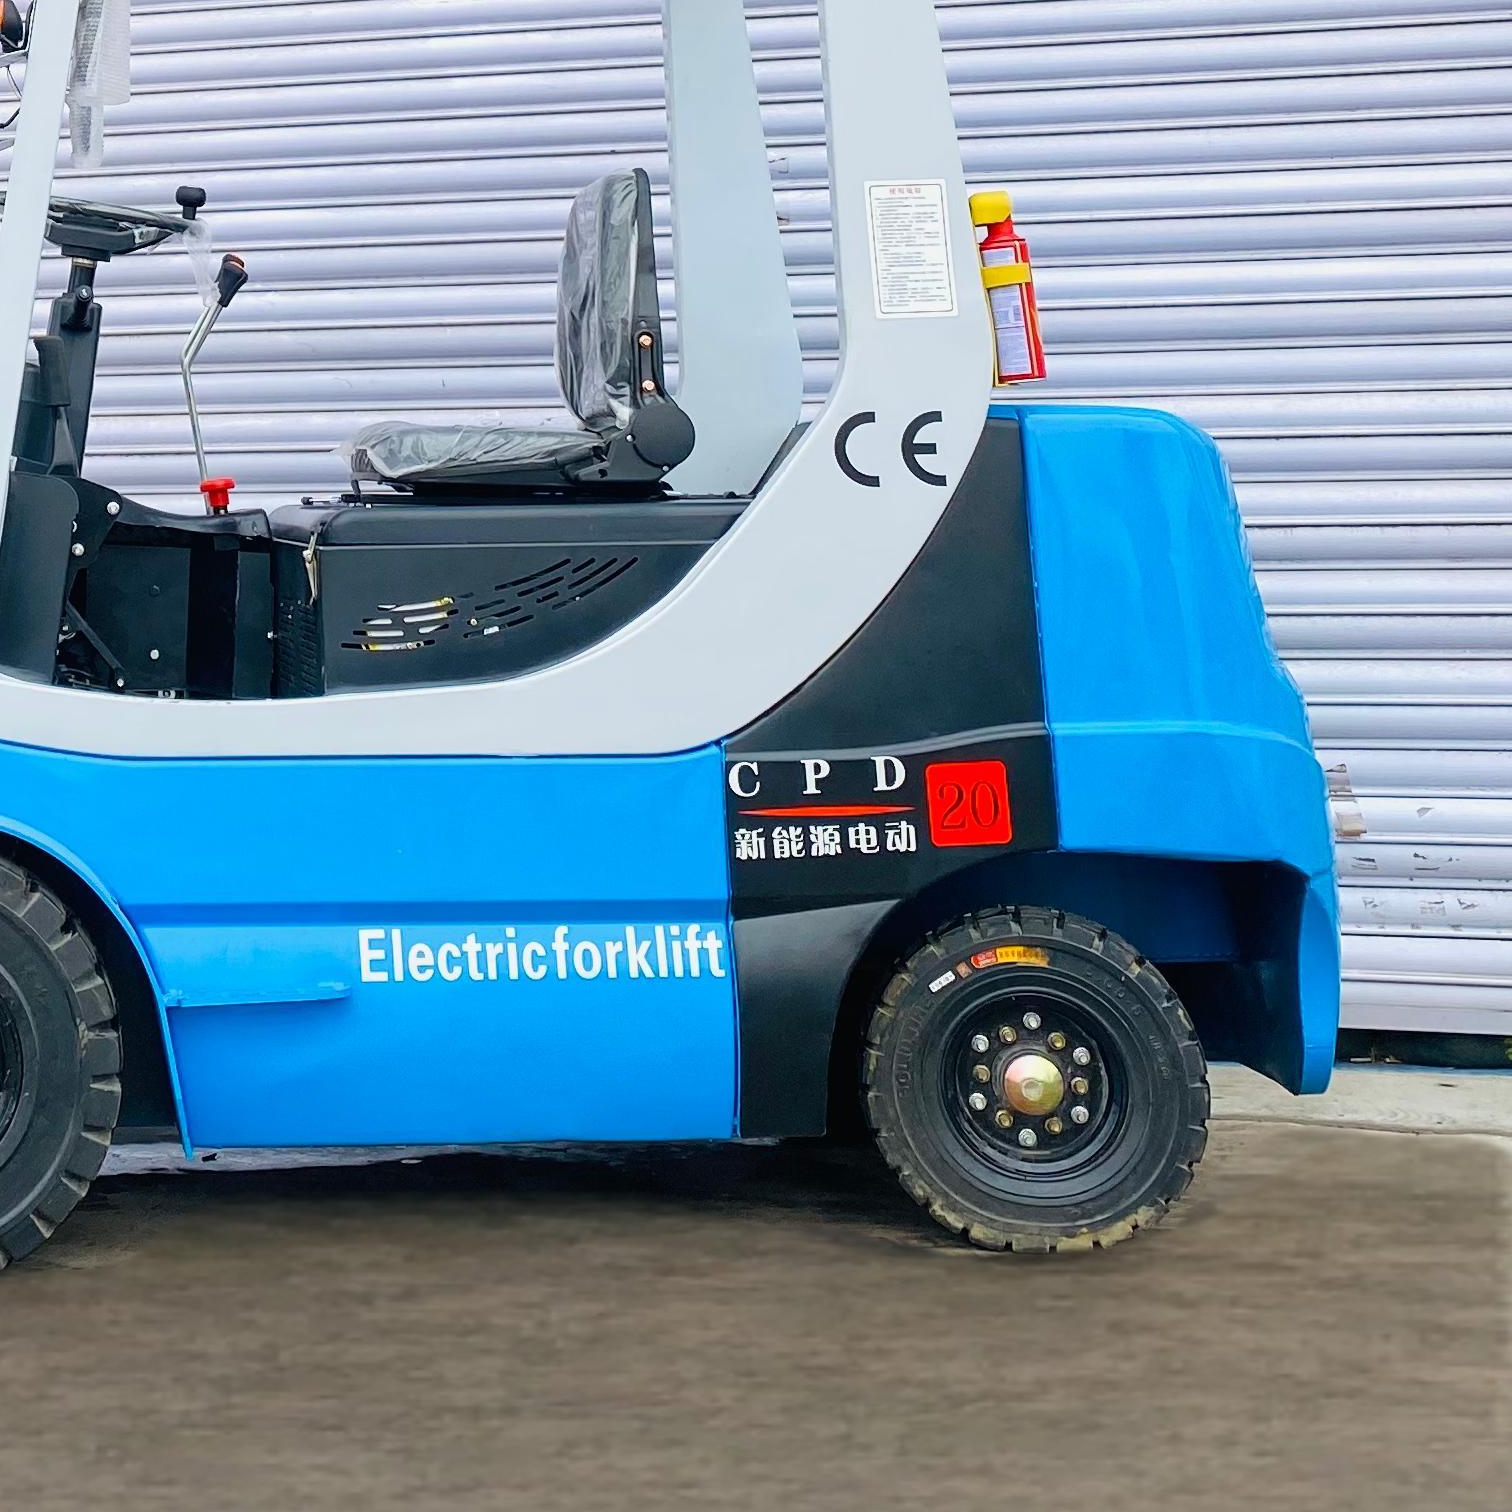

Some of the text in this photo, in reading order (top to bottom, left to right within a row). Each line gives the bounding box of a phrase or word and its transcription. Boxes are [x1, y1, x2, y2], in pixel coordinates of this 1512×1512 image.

[835, 411, 947, 487] CE
[937, 781, 1001, 831] 20
[733, 821, 917, 860] 新能源电动
